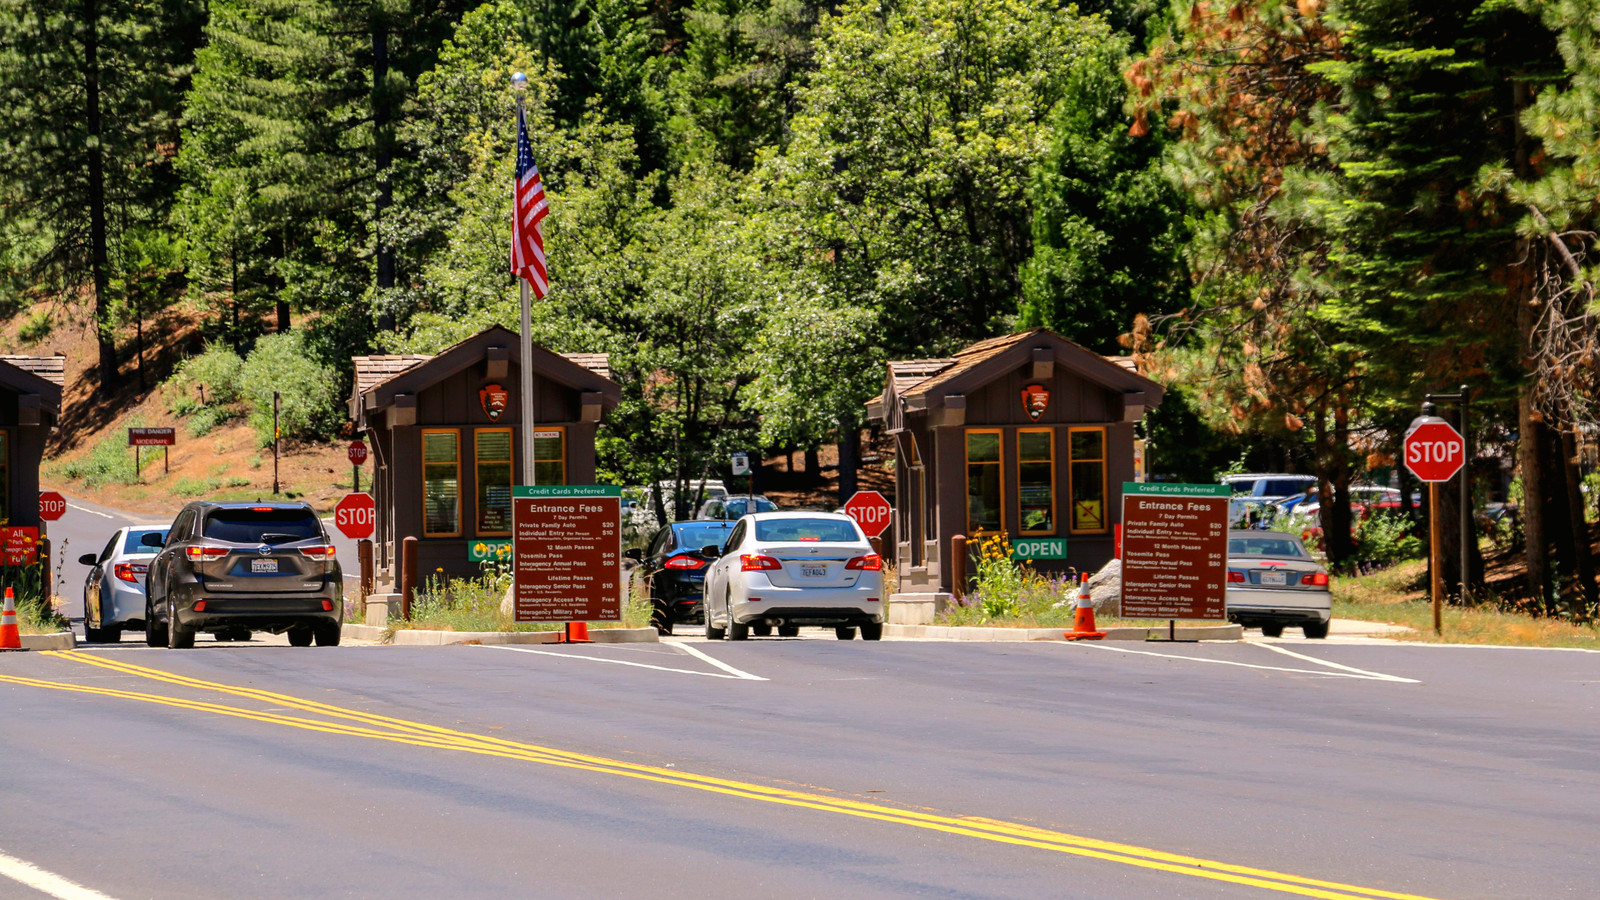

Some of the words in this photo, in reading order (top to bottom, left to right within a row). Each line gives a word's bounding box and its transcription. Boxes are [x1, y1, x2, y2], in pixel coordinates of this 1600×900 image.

[349, 448, 366, 458] STOP
[1409, 442, 1460, 462] STOP
[39, 501, 64, 512] STOP
[579, 504, 603, 512] Fees
[1139, 501, 1183, 510] Entrance
[1188, 503, 1211, 511] Fees
[848, 506, 888, 523] STOP
[473, 544, 513, 558] OPE
[1017, 542, 1062, 556] OPEN
